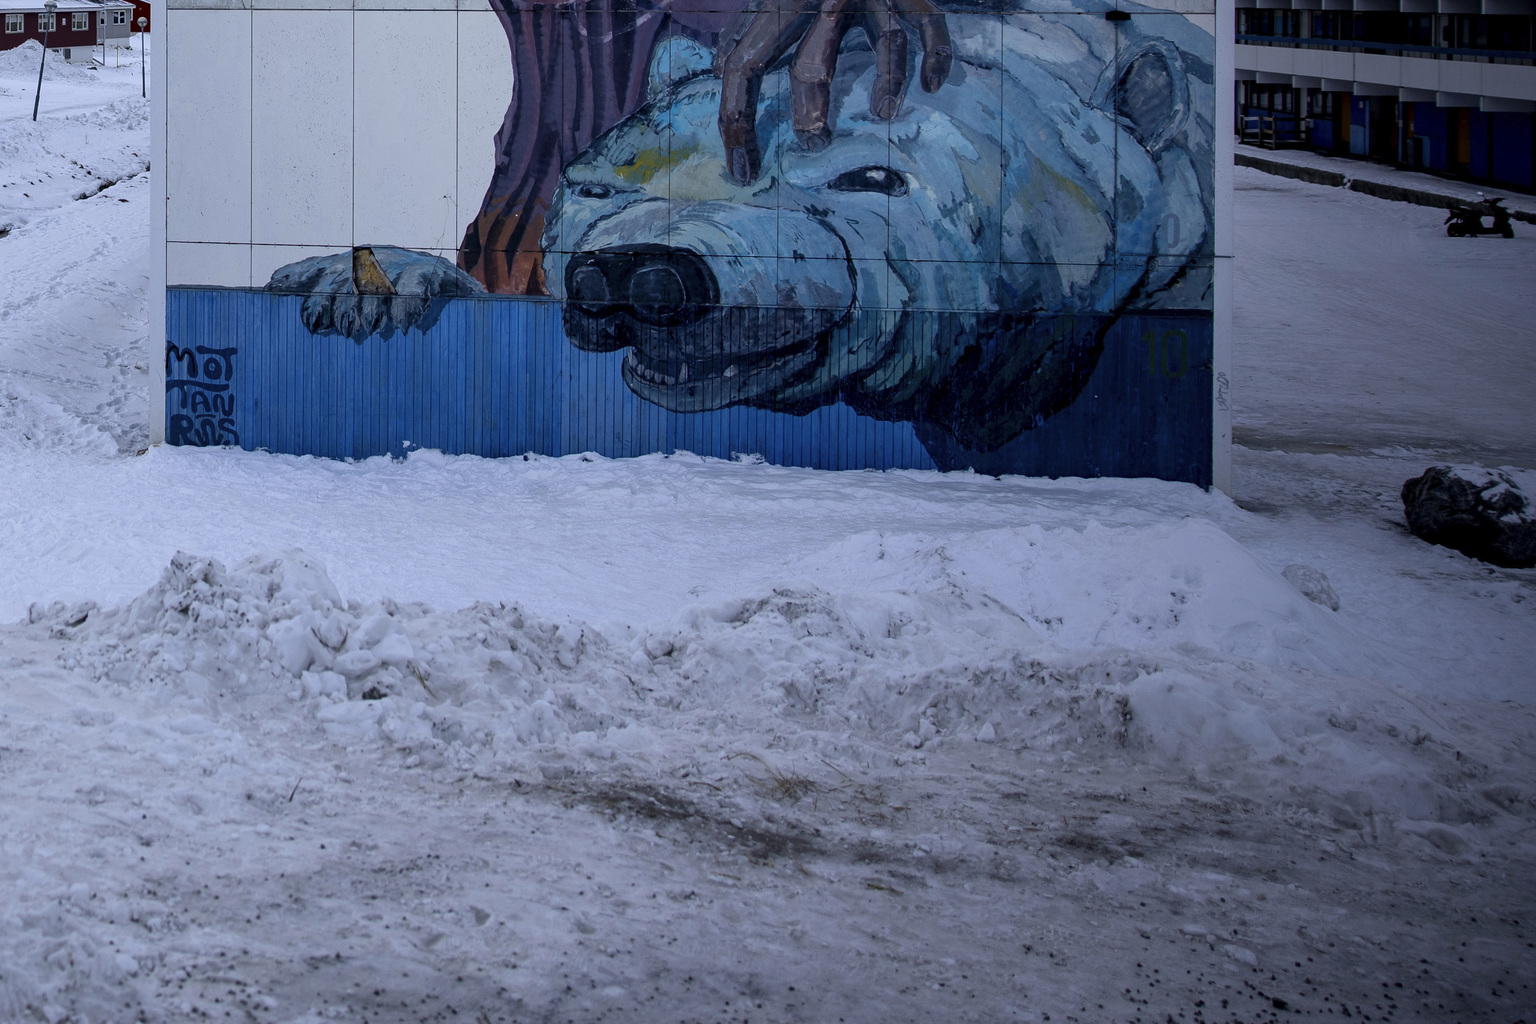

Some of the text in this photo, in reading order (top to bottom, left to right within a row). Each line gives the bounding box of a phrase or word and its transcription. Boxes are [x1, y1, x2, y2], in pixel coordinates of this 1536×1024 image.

[165, 340, 238, 381] MOT
[1141, 329, 1188, 378] 10
[165, 379, 235, 416] TAN
